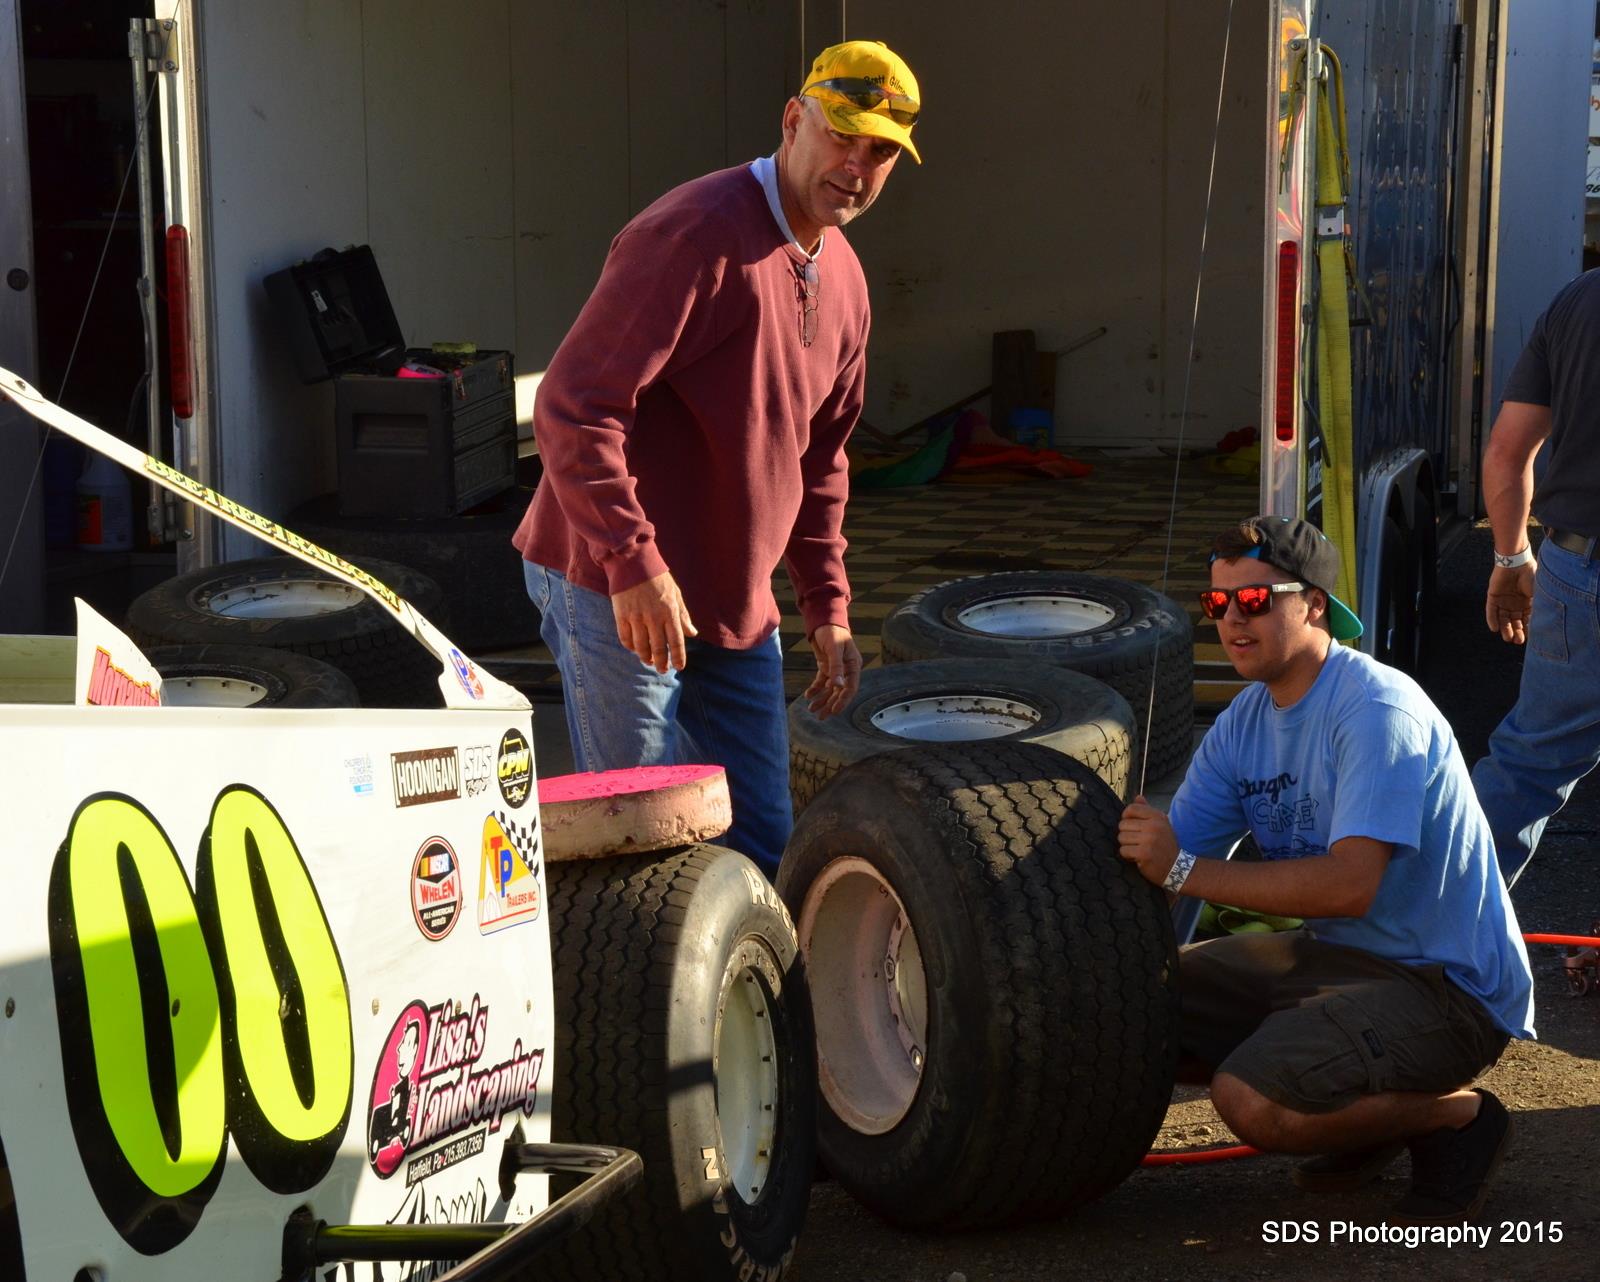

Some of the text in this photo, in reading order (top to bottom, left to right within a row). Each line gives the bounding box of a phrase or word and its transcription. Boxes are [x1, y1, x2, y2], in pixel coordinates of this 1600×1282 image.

[420, 877, 455, 905] WHELEN
[56, 784, 353, 1230] 00
[421, 995, 488, 1076] Lisa's
[409, 1041, 545, 1147] Landscaping
